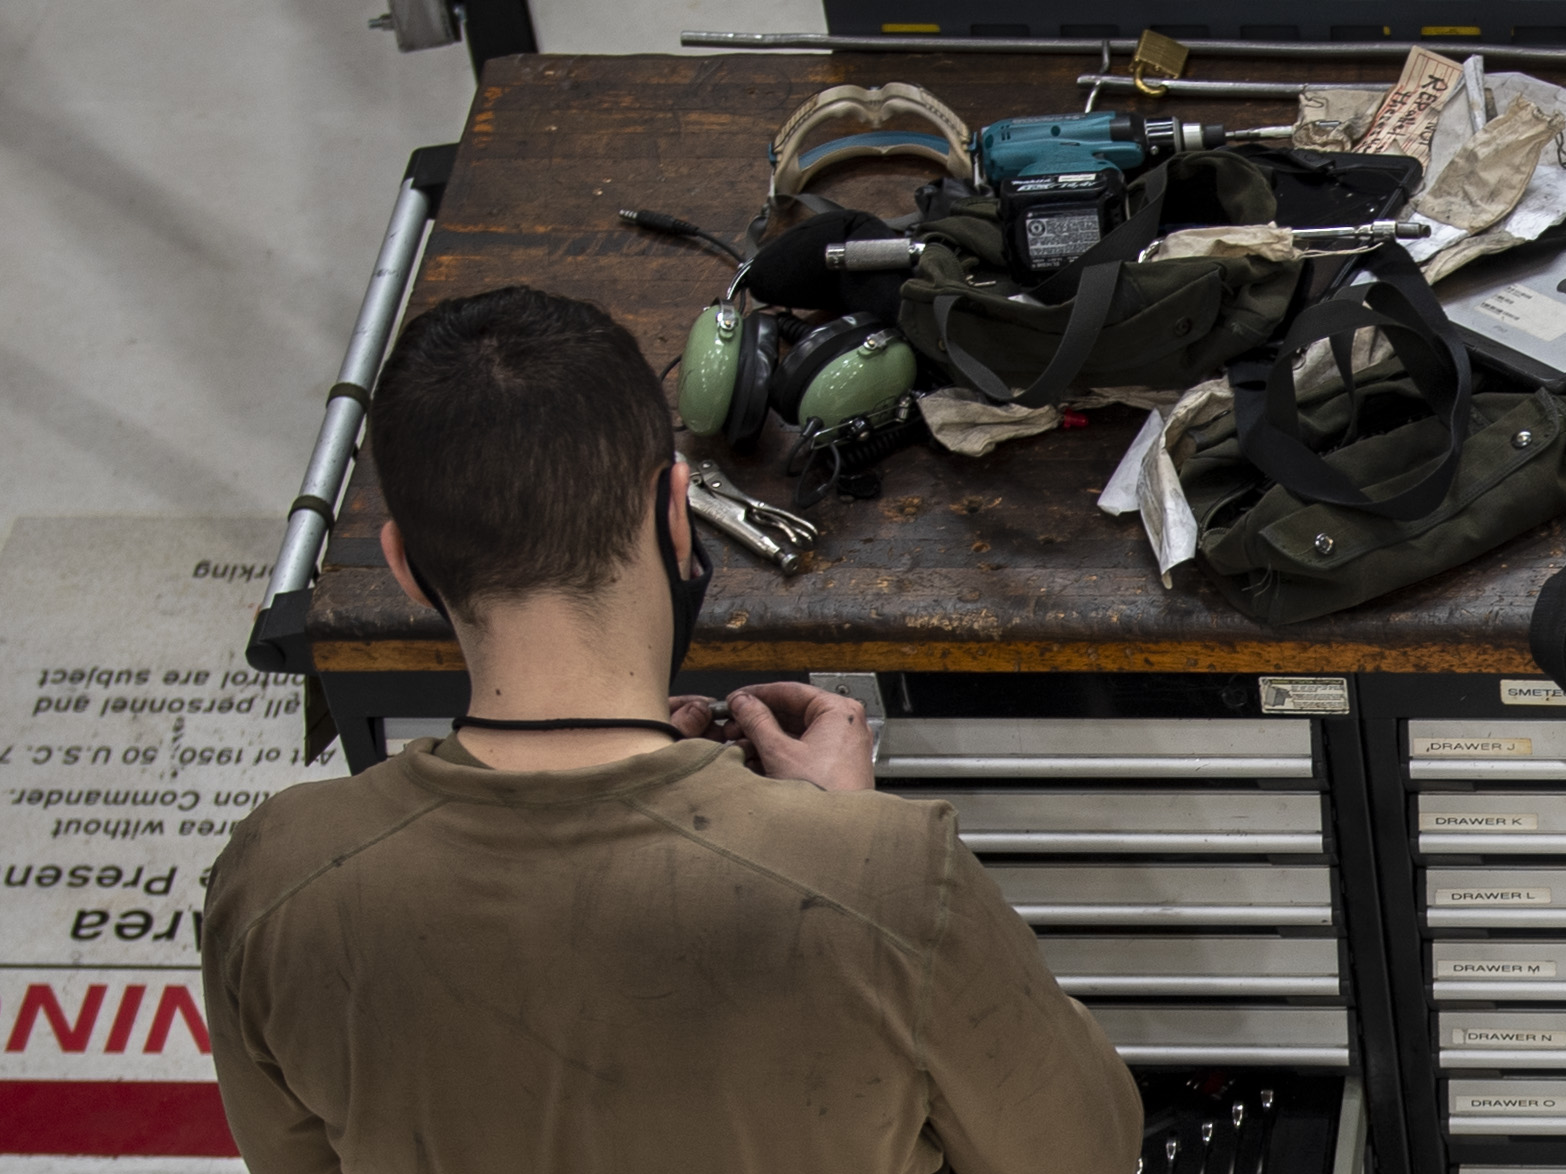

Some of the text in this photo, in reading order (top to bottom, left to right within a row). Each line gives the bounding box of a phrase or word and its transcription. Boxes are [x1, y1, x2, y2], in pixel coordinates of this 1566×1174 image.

[38, 668, 150, 689] subject
[163, 669, 210, 687] are
[34, 696, 301, 718] all personnel and
[26, 745, 111, 765] U.S.C.
[1430, 742, 1516, 751] DRAWER J
[122, 747, 158, 765] 50
[254, 747, 282, 765] of
[9, 788, 200, 811] Commander.
[51, 818, 164, 840] without
[1435, 817, 1522, 825] DRAWER K
[0, 864, 177, 896] Presen
[1451, 891, 1536, 900] DRAWER L
[70, 908, 202, 952] rea
[1453, 964, 1541, 974] DRAWER M
[1467, 1032, 1552, 1042] DRAWER N
